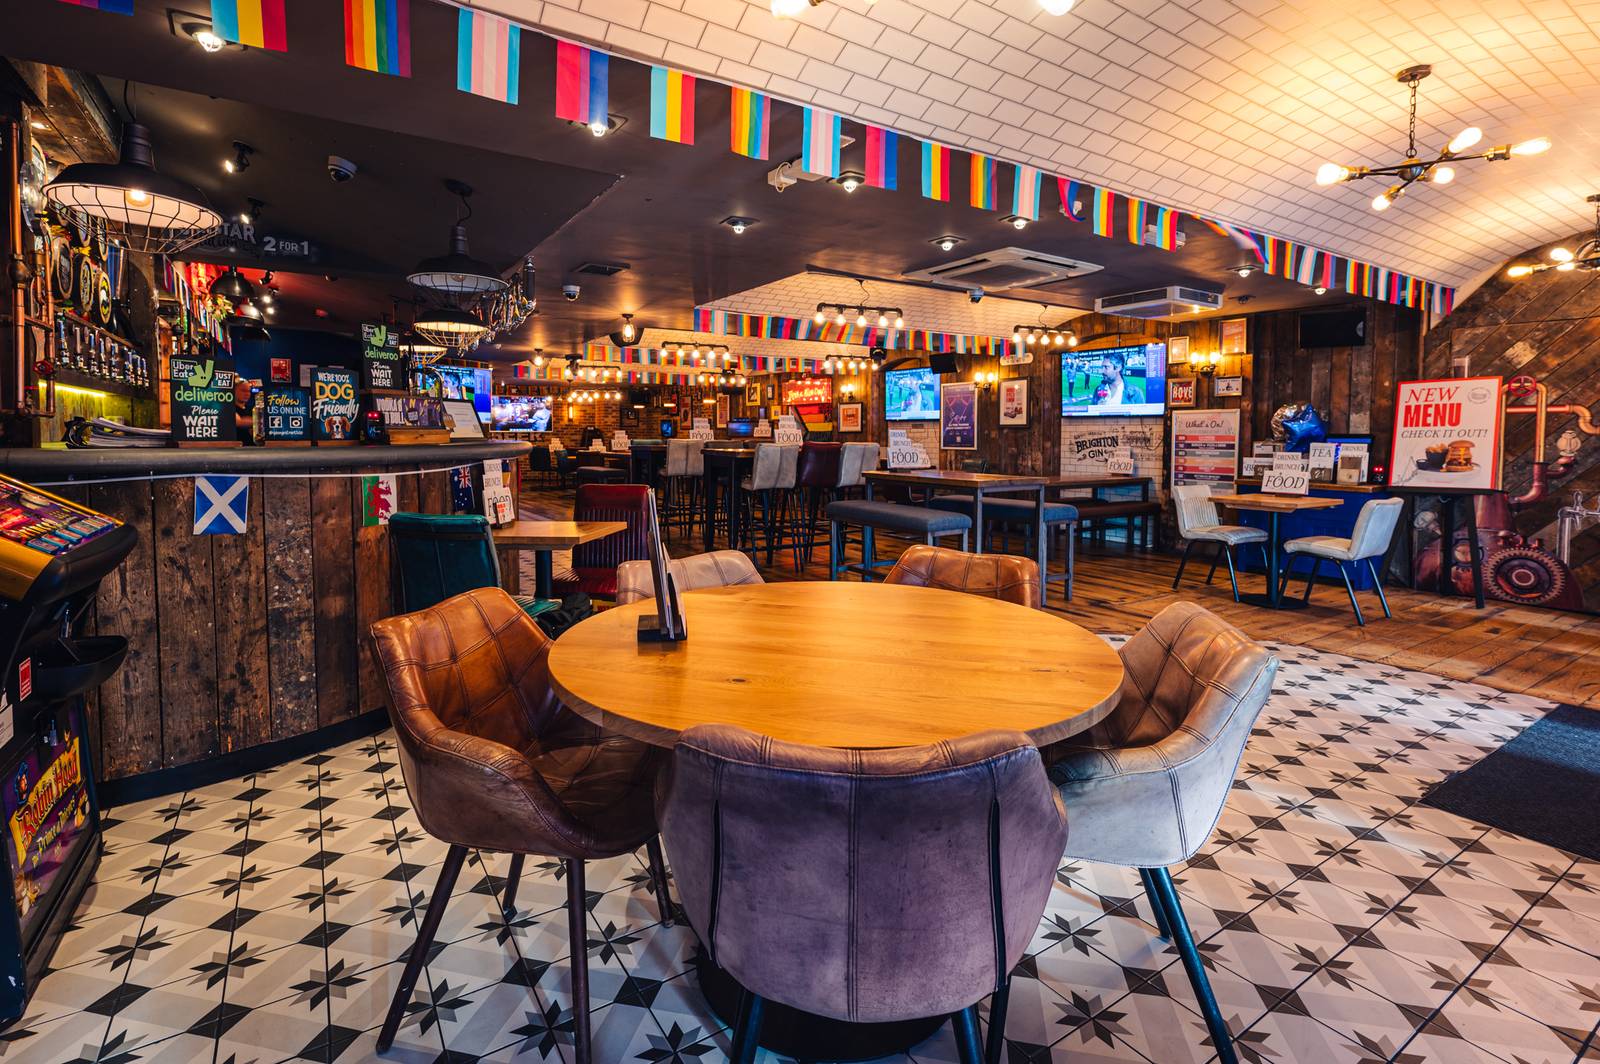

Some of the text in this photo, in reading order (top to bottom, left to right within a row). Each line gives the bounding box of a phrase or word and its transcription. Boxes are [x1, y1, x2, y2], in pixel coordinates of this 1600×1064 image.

[263, 236, 309, 255] 2 FOR 1
[365, 346, 399, 360] deliveroo
[173, 361, 194, 370] Uber
[173, 369, 194, 378] Eats
[371, 369, 392, 378] WAIT
[175, 385, 233, 402] deliveroo
[315, 382, 354, 400] DOG
[1405, 386, 1461, 403] NEW
[267, 394, 299, 406] Follow
[191, 405, 219, 415] Please
[267, 406, 307, 415] US ONLINE
[313, 398, 360, 419] Friendly
[183, 415, 218, 426] WAIT
[1403, 403, 1462, 428] MENU
[186, 427, 218, 438] HERE
[778, 432, 802, 442] FOOD
[1401, 429, 1488, 439] CHECK IT OUT!
[1075, 436, 1119, 454] BRIGHTON
[892, 452, 919, 463] FOOD
[1088, 449, 1104, 458] GIN
[1312, 448, 1332, 457] TEA
[1109, 461, 1132, 471] FOOD
[1265, 475, 1305, 489] FOOD
[16, 752, 78, 850] Robin Hood
